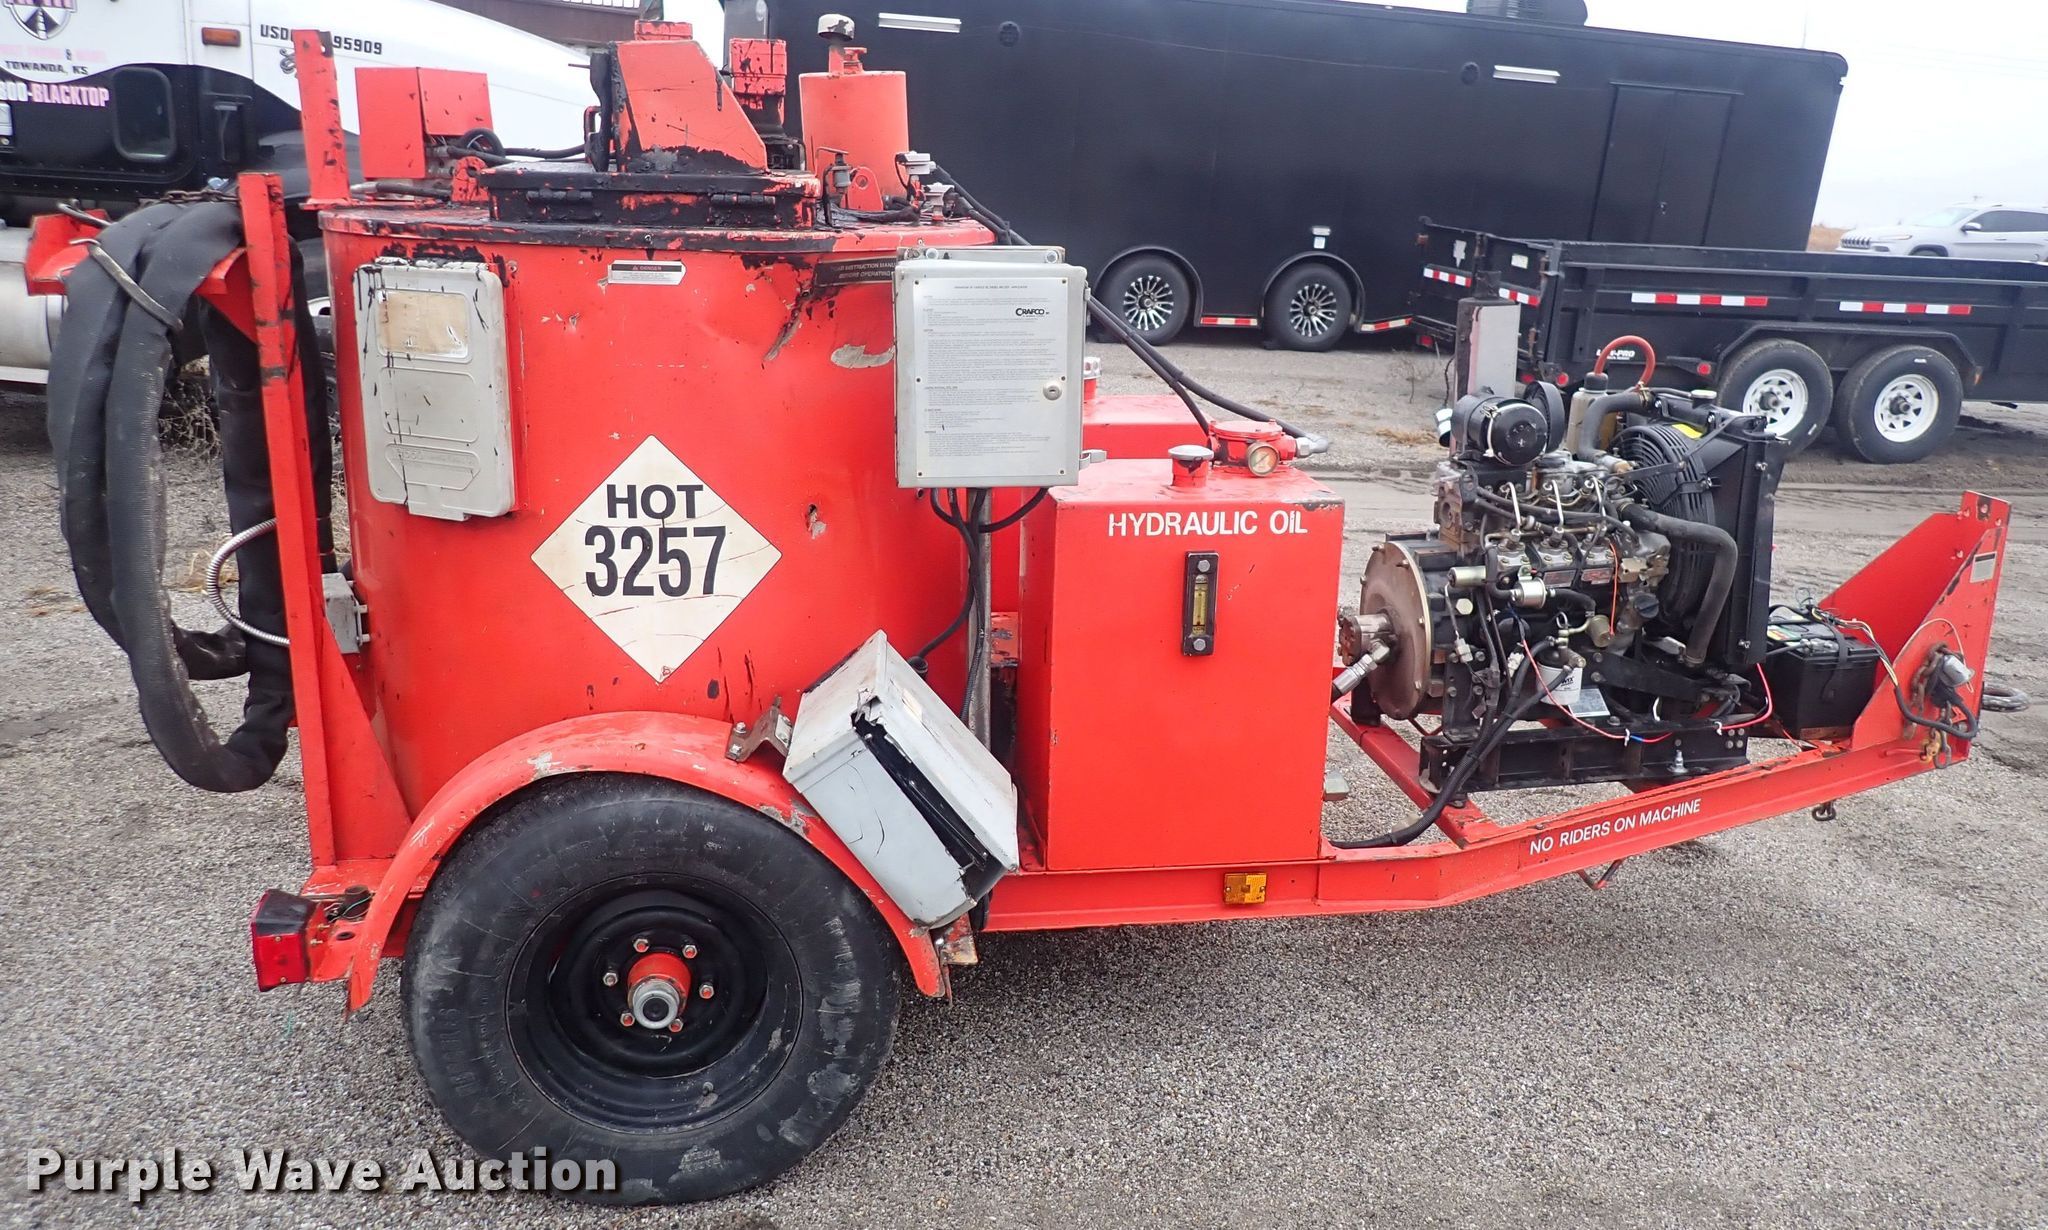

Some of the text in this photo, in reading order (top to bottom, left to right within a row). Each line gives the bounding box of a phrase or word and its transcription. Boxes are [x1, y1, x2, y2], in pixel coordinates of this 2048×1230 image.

[5, 60, 88, 76] TOWANDA, KS
[880, 261, 896, 269] MANU
[1015, 307, 1045, 317] CRAFCO
[606, 484, 703, 519] HOT
[1108, 510, 1308, 537] HYDRAULIC OIL
[584, 525, 726, 597] 3257
[1529, 799, 1701, 855] NO RIDERS ON MACHINE
